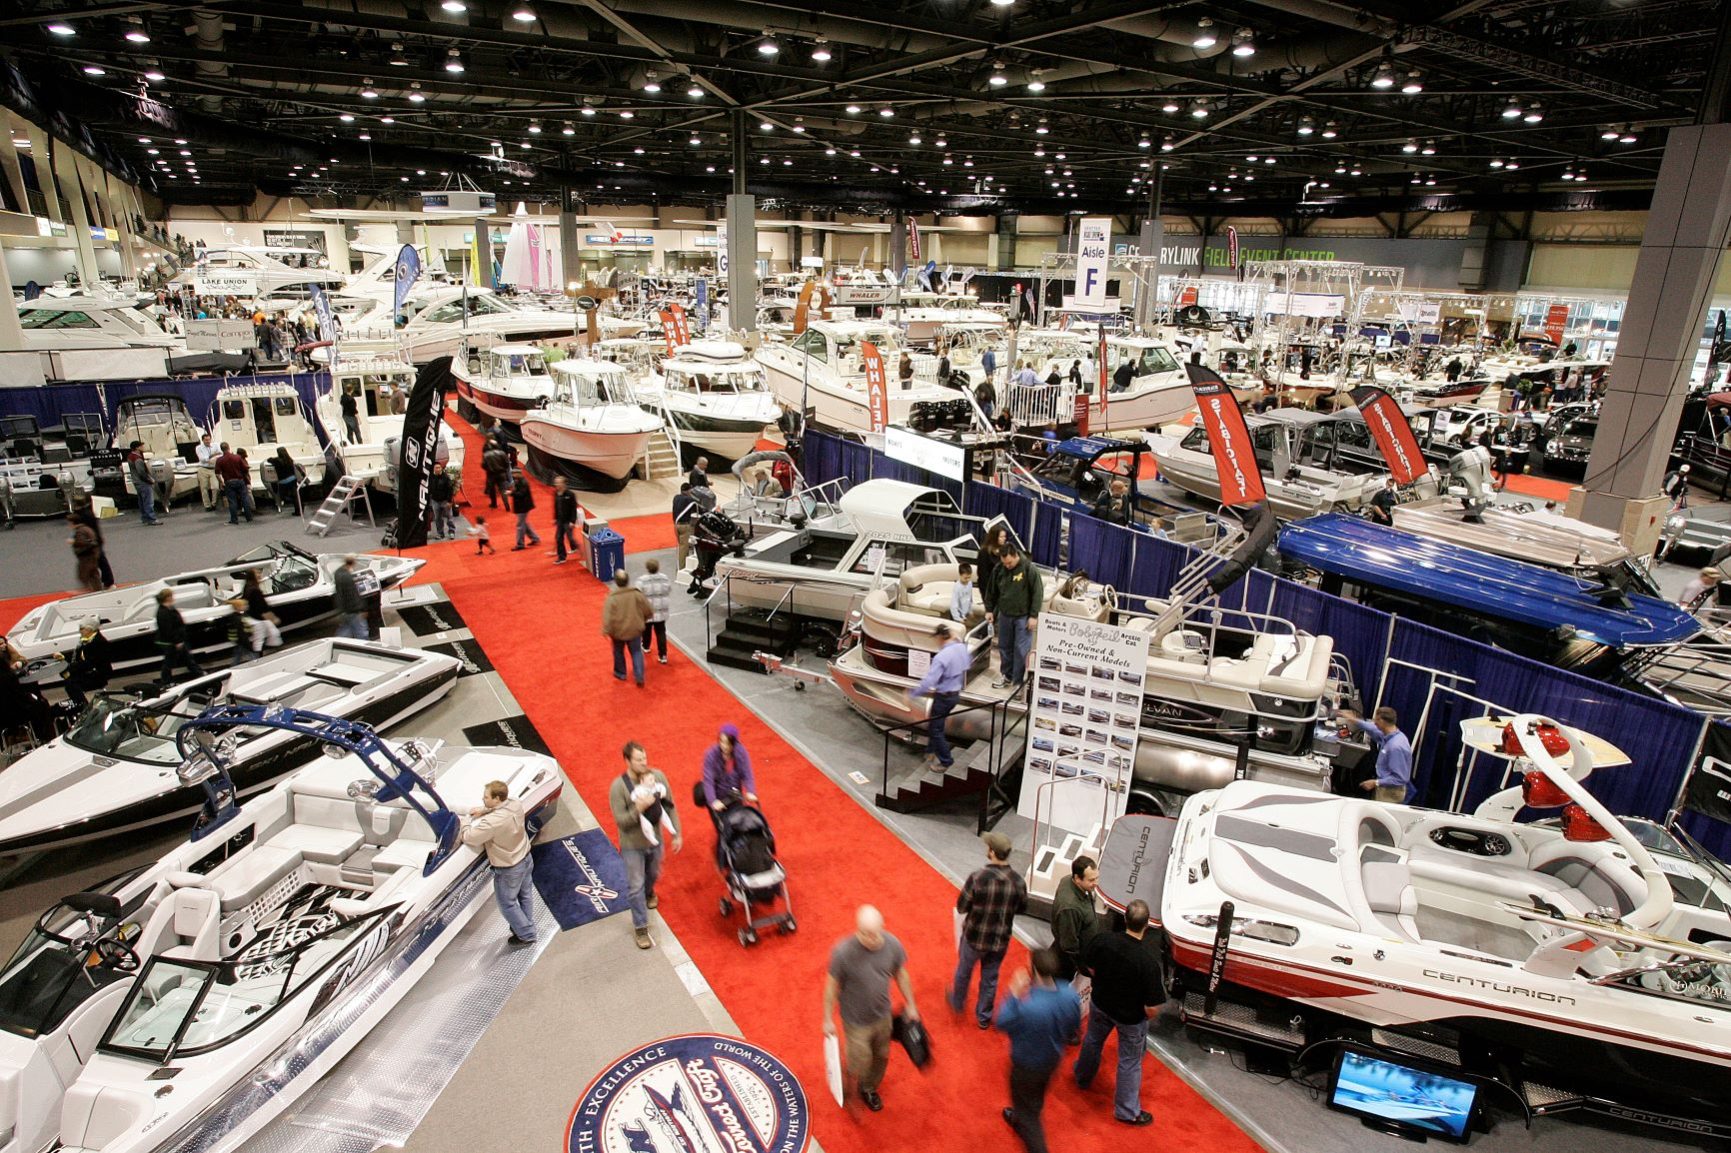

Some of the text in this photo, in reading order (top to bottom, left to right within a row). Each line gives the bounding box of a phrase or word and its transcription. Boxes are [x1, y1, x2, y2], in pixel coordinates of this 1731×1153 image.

[1082, 246, 1105, 258] Aisle
[1085, 268, 1098, 296] F
[418, 387, 441, 522] NAUTIQUE
[1047, 625, 1067, 633] Motors
[1120, 633, 1141, 642] Arctic
[1046, 645, 1131, 668] Non-Current Models
[1059, 639, 1107, 655] Pre-Owned
[1126, 826, 1151, 894] CENTURION
[1423, 969, 1576, 1006] CENTURION
[714, 1042, 752, 1060] WORLD
[752, 1055, 772, 1072] THE
[585, 1047, 667, 1116] EXCELLENCE
[770, 1070, 784, 1081] OF
[730, 1074, 760, 1119] ESTABLISHED
[779, 1081, 799, 1116] WATERS
[787, 1118, 800, 1139] THE
[1609, 1107, 1713, 1133] CENTURION
